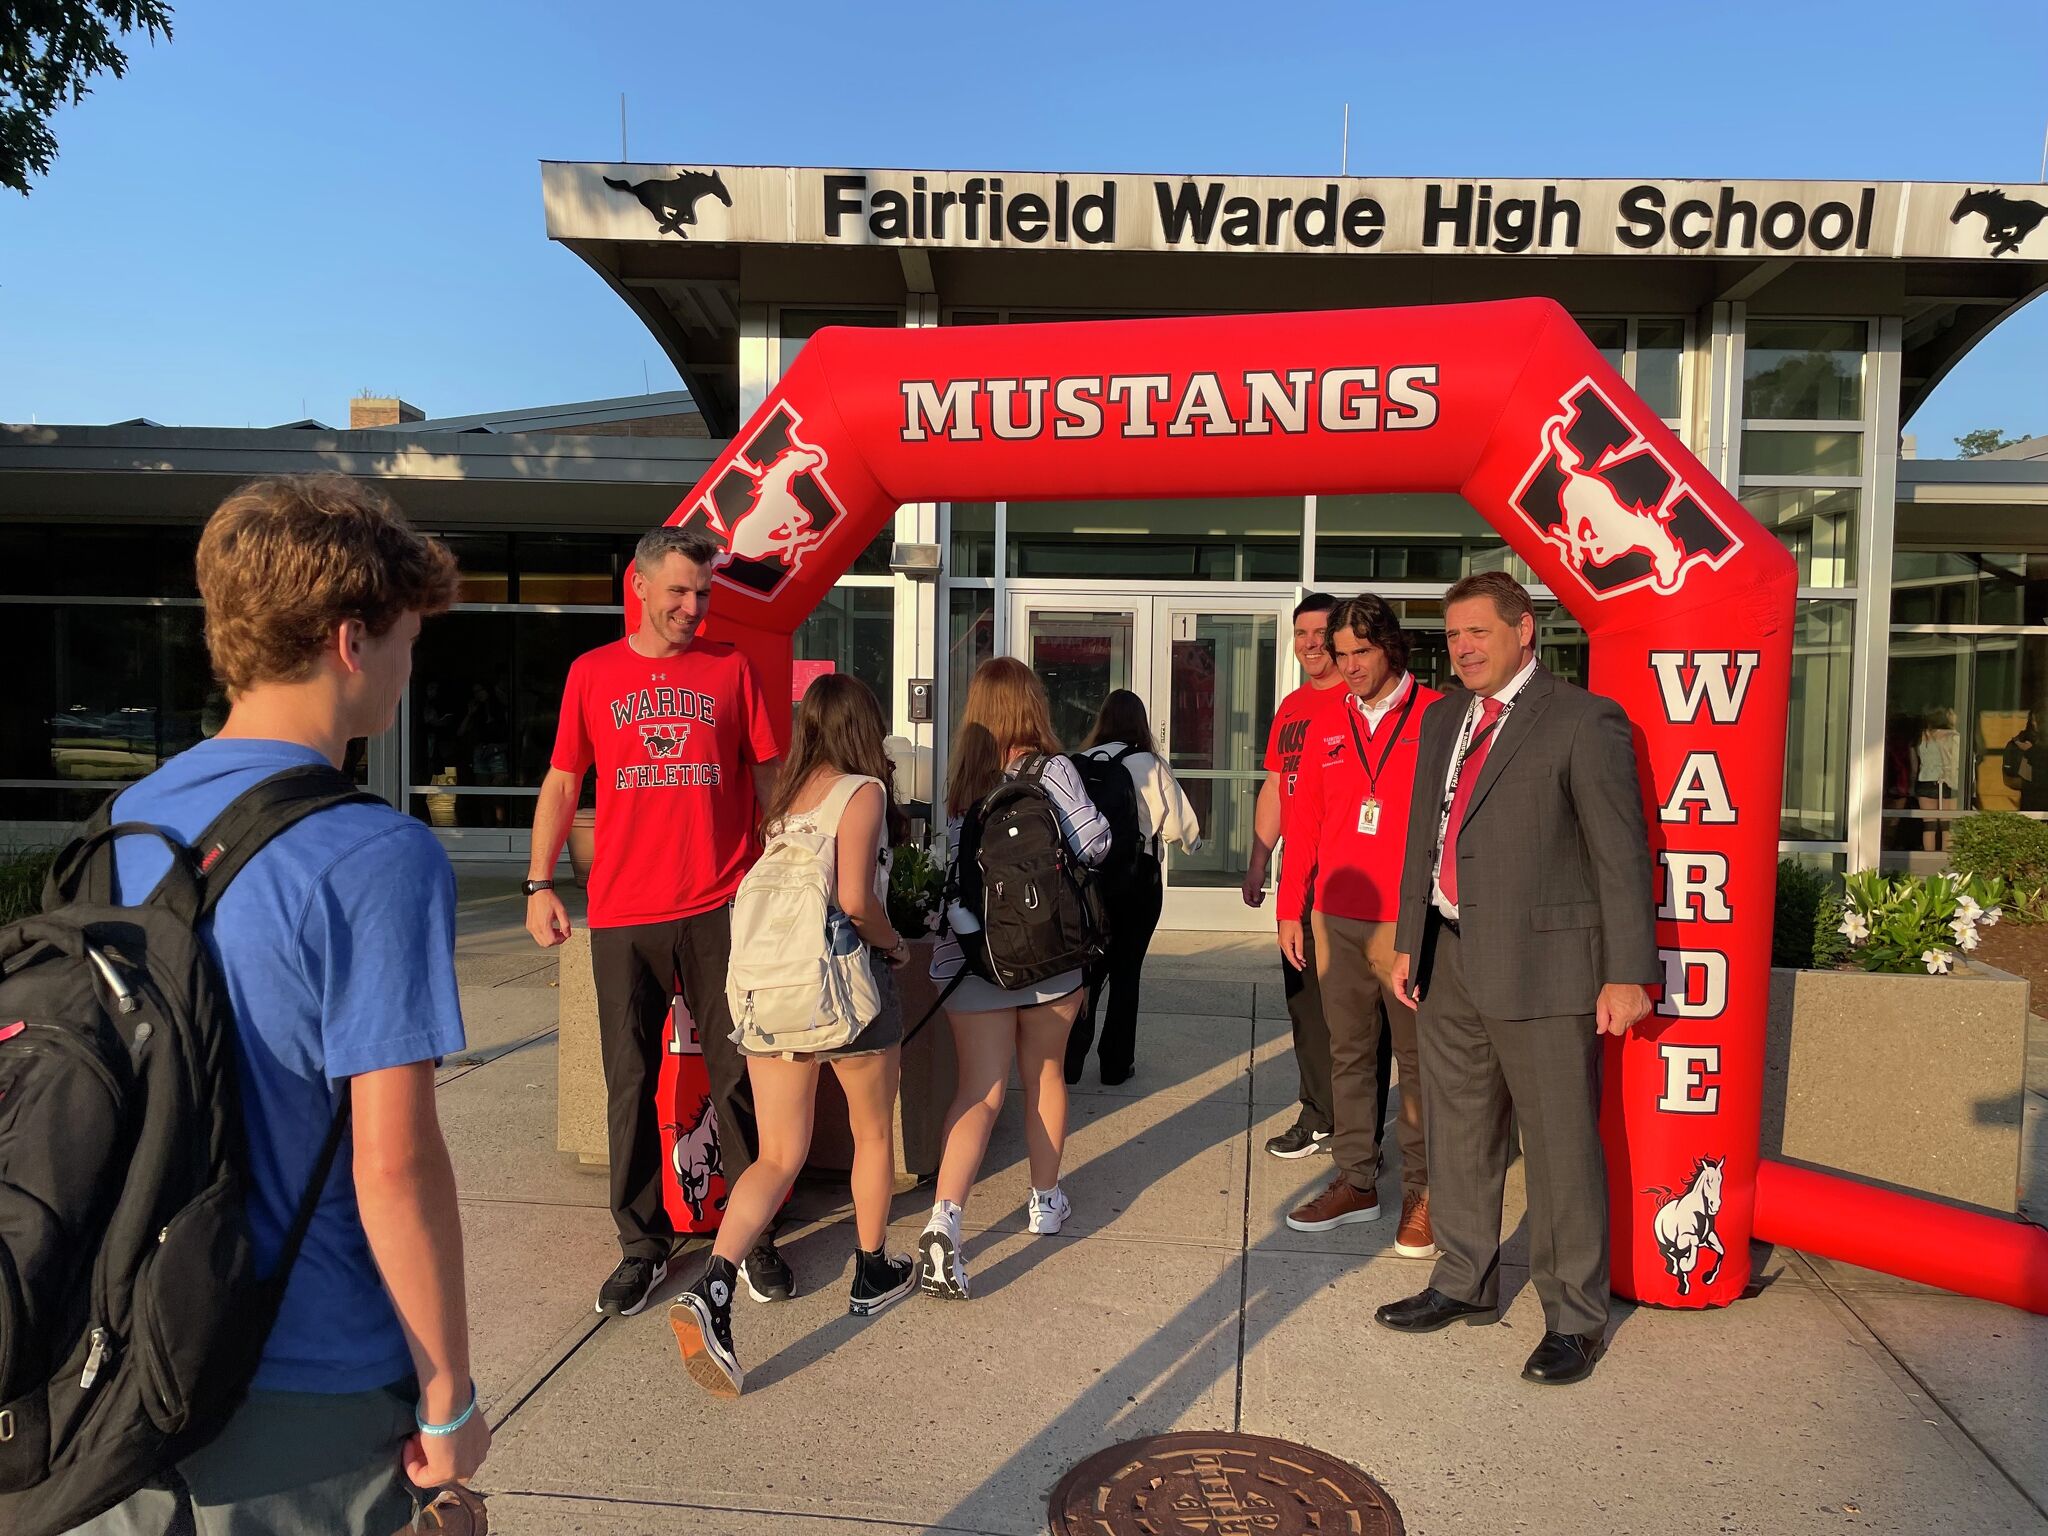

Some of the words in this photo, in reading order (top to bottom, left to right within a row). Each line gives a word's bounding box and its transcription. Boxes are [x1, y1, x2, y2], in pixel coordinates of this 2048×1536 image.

[823, 175, 1116, 244] Fairfield
[1154, 181, 1386, 248] Warde
[1422, 183, 1581, 253] High
[1615, 184, 1876, 251] School
[899, 363, 1440, 441] MUSTANGS
[610, 686, 717, 729] WARDE
[615, 763, 721, 790] ATHLETICS
[1648, 649, 1761, 1116] WARDE
